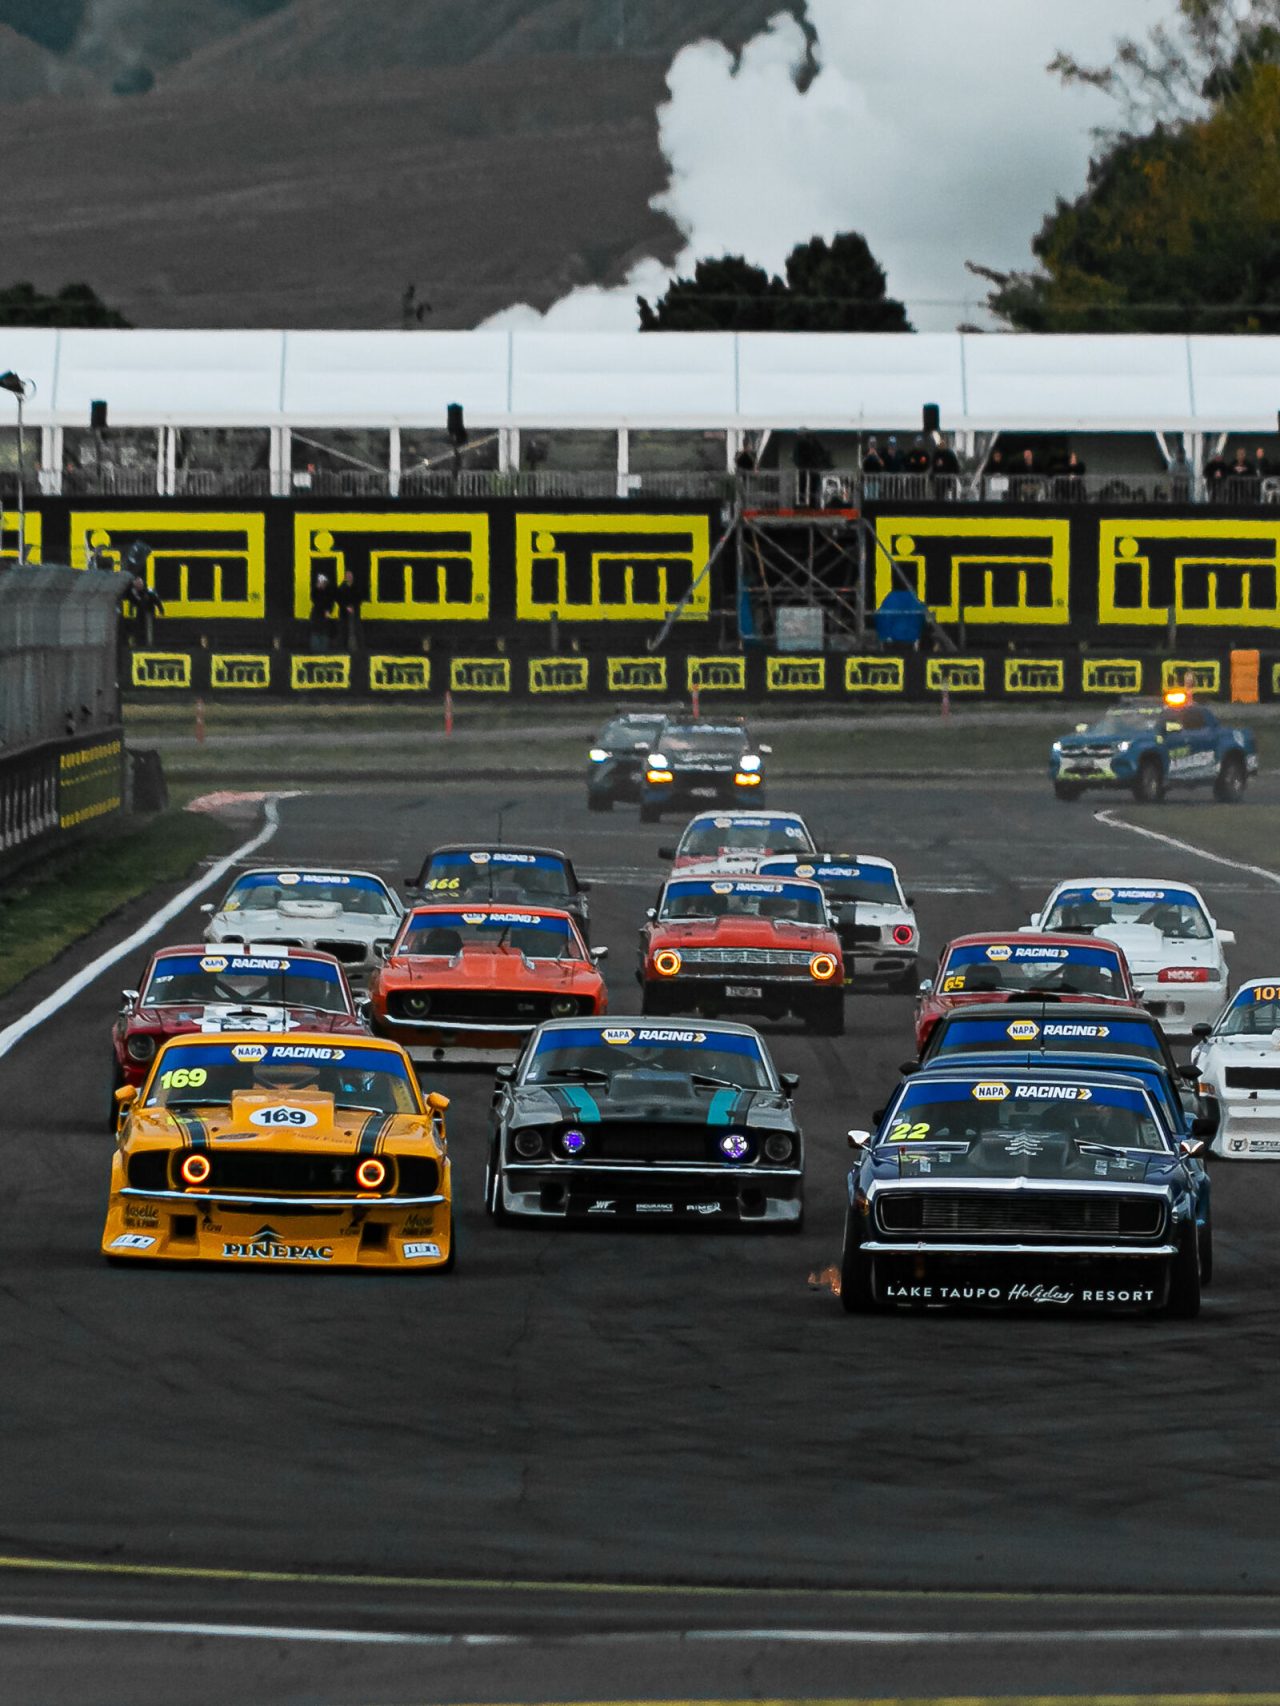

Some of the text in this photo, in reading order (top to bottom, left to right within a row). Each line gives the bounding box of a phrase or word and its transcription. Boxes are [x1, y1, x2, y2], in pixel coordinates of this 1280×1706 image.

[1015, 948, 1060, 958] RACING
[232, 958, 280, 970] RACING
[607, 1030, 694, 1041] NAPA RACING
[1012, 1025, 1098, 1036] NAPA RACING
[237, 1046, 331, 1059] NAPA RACING
[160, 1068, 207, 1089] 169
[976, 1085, 1078, 1100] NAPA RACING
[260, 1108, 307, 1125] 169
[889, 1122, 930, 1140] 22
[223, 1241, 334, 1260] PINEPAC
[887, 1283, 1154, 1303] LAKE TAUPO Holiday RESORT
